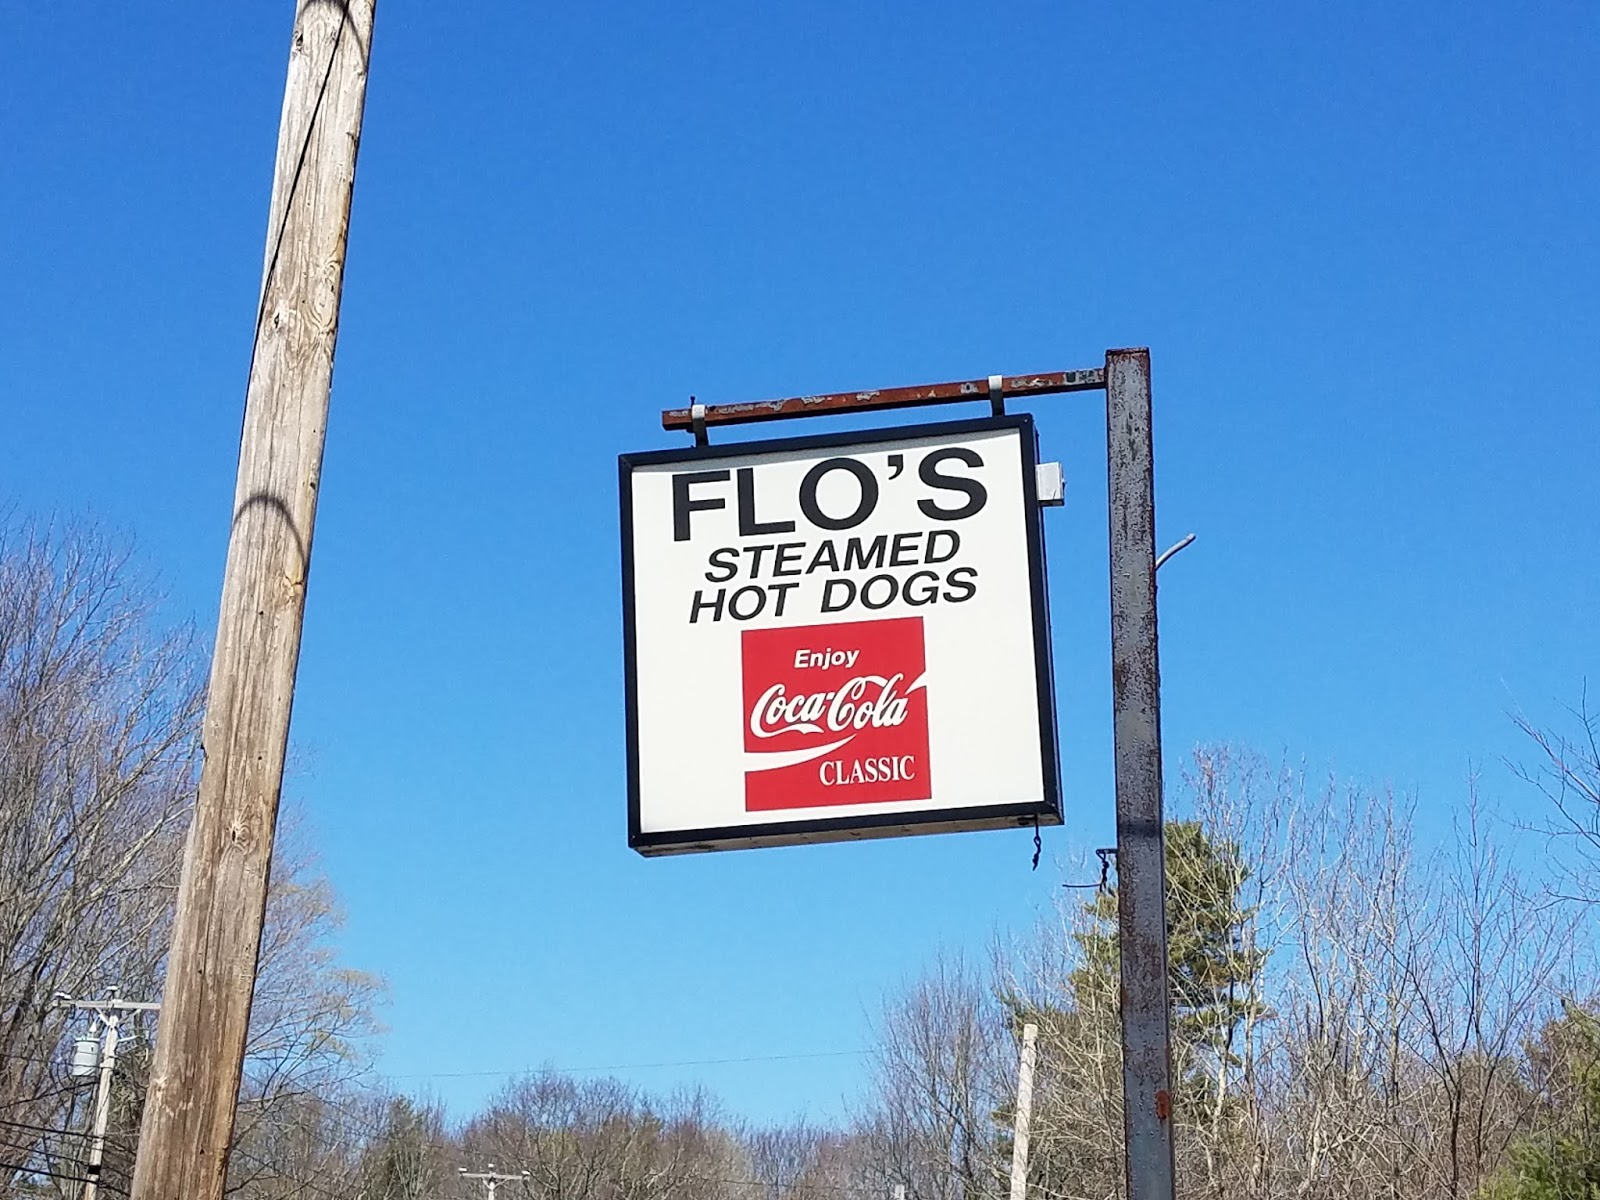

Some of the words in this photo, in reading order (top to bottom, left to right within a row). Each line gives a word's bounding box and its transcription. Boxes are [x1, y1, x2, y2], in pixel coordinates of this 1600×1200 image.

[672, 447, 988, 542] FLO'S
[704, 529, 961, 584] STEAMED
[689, 582, 799, 624] HOT
[820, 567, 978, 613] DOGS
[794, 648, 860, 670] Enjoy
[750, 673, 909, 739] Coca-Cola
[819, 755, 915, 786] CLASSIC
